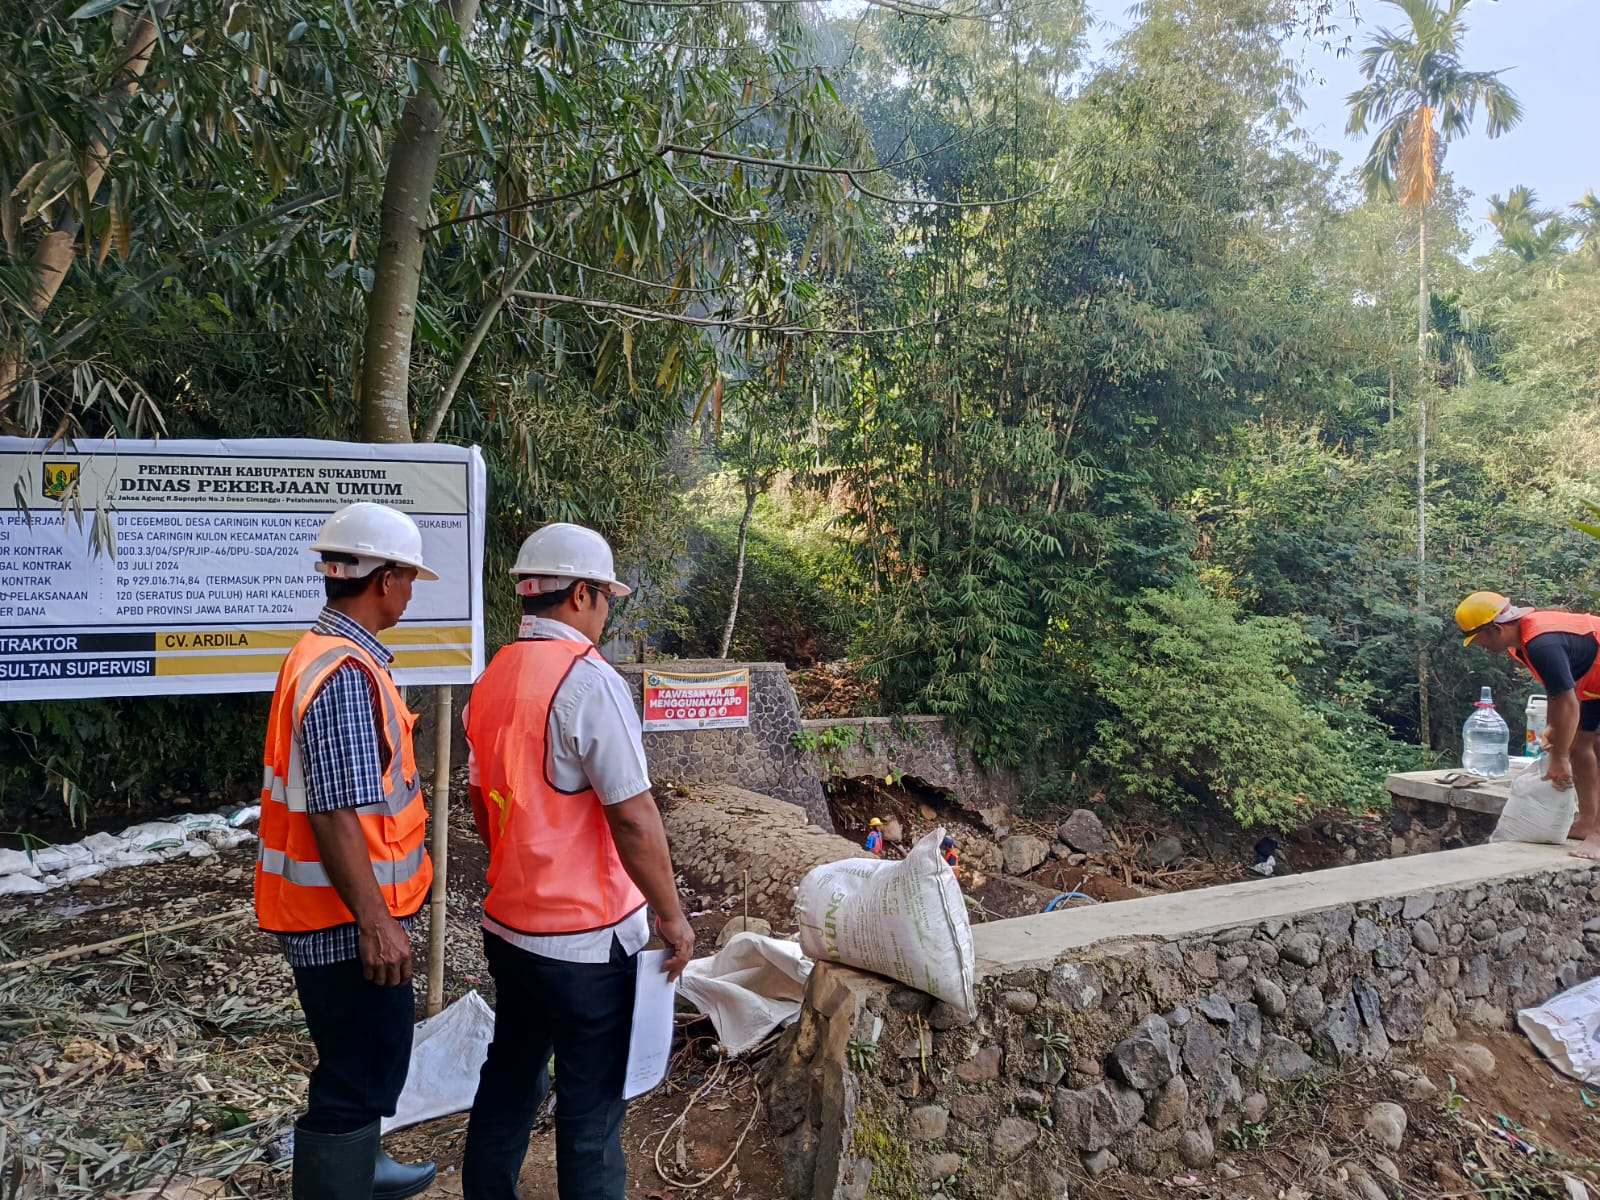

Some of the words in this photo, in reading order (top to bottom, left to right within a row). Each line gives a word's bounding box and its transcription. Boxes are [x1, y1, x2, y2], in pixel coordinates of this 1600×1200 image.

[138, 464, 232, 477] PEMERINTAH
[236, 466, 315, 478] KABUPATEN
[318, 468, 387, 480] SUKABUMI
[119, 478, 191, 492] DINAS
[197, 479, 330, 495] PEKERJAAN
[335, 482, 404, 496] UMUM
[141, 495, 165, 503] Agung
[117, 516, 127, 526] DI
[130, 516, 183, 526] CEGEMBOL
[185, 517, 211, 526] DESA
[214, 517, 259, 527] CARINGIN
[261, 518, 292, 527] KULON
[418, 520, 462, 528] SUKABUMI
[117, 532, 144, 541] DESA
[146, 532, 193, 541] CARINGIN
[196, 532, 227, 541] KULON
[230, 532, 287, 541] KECAMATAN
[289, 532, 320, 542] CARIN
[14, 546, 63, 556] KONTRAK
[0, 561, 19, 571] GAL
[23, 560, 72, 571] KONTRAK
[117, 561, 129, 570] 03
[132, 561, 153, 570] JULI
[156, 561, 179, 570] 2024
[2, 576, 52, 586] KONTRAK
[116, 576, 130, 587] Rp
[206, 576, 260, 586] (TERMASUK
[263, 576, 282, 585] PPN
[284, 576, 304, 584] DAN
[10, 592, 88, 601] PELAKSANAAN
[116, 591, 132, 600] 120
[135, 591, 183, 602] (SERATUS
[186, 591, 206, 600] DUA
[208, 590, 243, 601] PULUH)
[246, 590, 268, 599] HARI
[271, 590, 320, 599] KALENDER
[0, 607, 13, 617] ER
[17, 606, 46, 616] DANA
[116, 606, 144, 616] APBD
[146, 606, 193, 615] PROVINSI
[195, 605, 222, 614] JAWA
[224, 605, 254, 614] BARAT
[0, 637, 78, 652] TRAKTOR
[165, 635, 189, 648] CV.
[192, 633, 249, 647] ARDILA
[0, 663, 61, 678] SULTAN
[66, 660, 150, 676] SUPERVISI
[658, 689, 706, 699] KAWASAN
[706, 688, 735, 698] WAJIB
[649, 698, 722, 708] MENGGUNAKAN
[723, 697, 742, 706] APD
